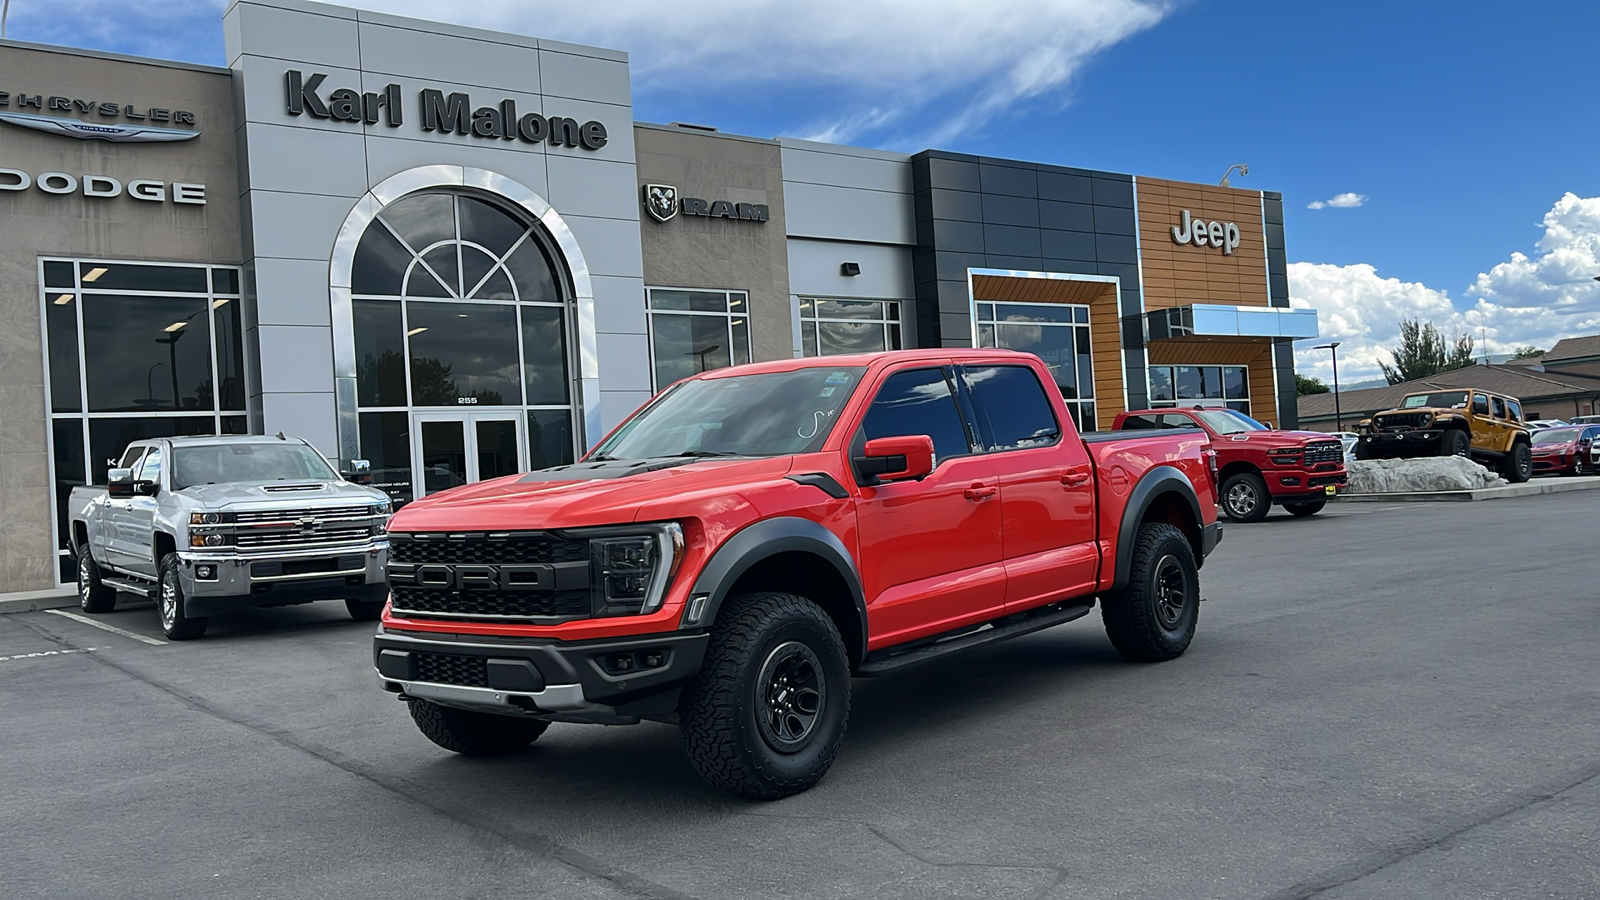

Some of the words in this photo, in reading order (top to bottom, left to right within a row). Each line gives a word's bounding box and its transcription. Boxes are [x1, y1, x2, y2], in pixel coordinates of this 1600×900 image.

[284, 69, 403, 128] Karl
[421, 88, 608, 151] Malone
[0, 168, 206, 205] DODGE
[681, 197, 769, 222] RAM
[1171, 209, 1240, 255] Jeep
[385, 563, 553, 591] FORD
